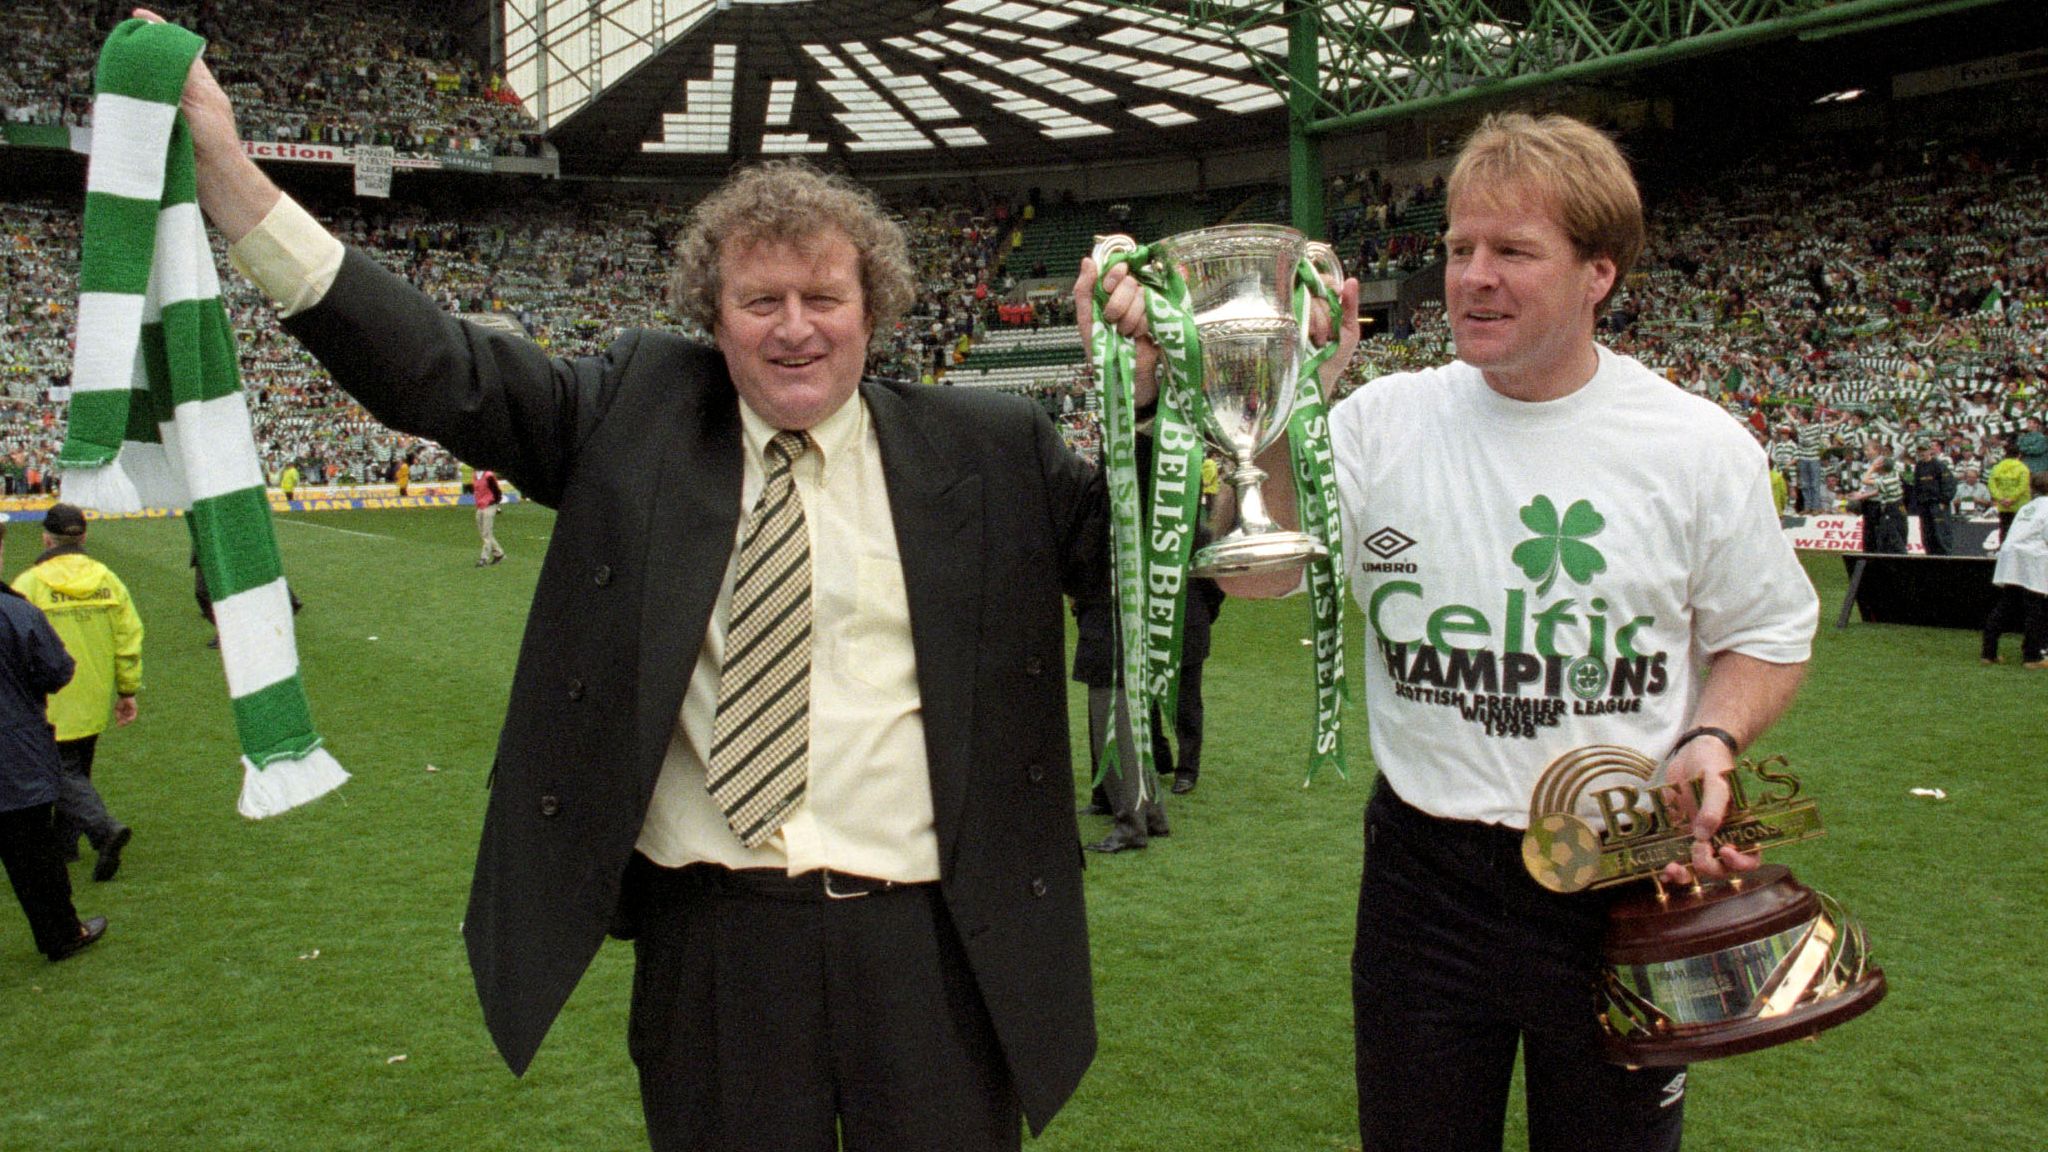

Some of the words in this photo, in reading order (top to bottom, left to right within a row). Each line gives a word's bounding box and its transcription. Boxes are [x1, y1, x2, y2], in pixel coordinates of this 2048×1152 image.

[241, 141, 333, 160] iction
[1150, 417, 1197, 554] BELL'S
[1304, 415, 1341, 545] BELL'S
[303, 499, 352, 512] IAN
[362, 495, 460, 509] SKELLY
[1816, 519, 1845, 530] ON
[1823, 530, 1864, 540] EVE
[1362, 562, 1418, 574] UMBRO
[51, 587, 112, 603] STRD
[1149, 560, 1183, 698] BELL'S
[1369, 580, 1656, 664] Celtic
[1377, 636, 1669, 699] HAMPIONS
[1316, 628, 1341, 755] BELL'S
[1460, 703, 1560, 727] WINNERS
[1473, 694, 1567, 717] PREMIER
[1573, 698, 1642, 716] LEAGUE
[1484, 720, 1536, 739] 1998
[1676, 824, 1781, 857] CMPIONS
